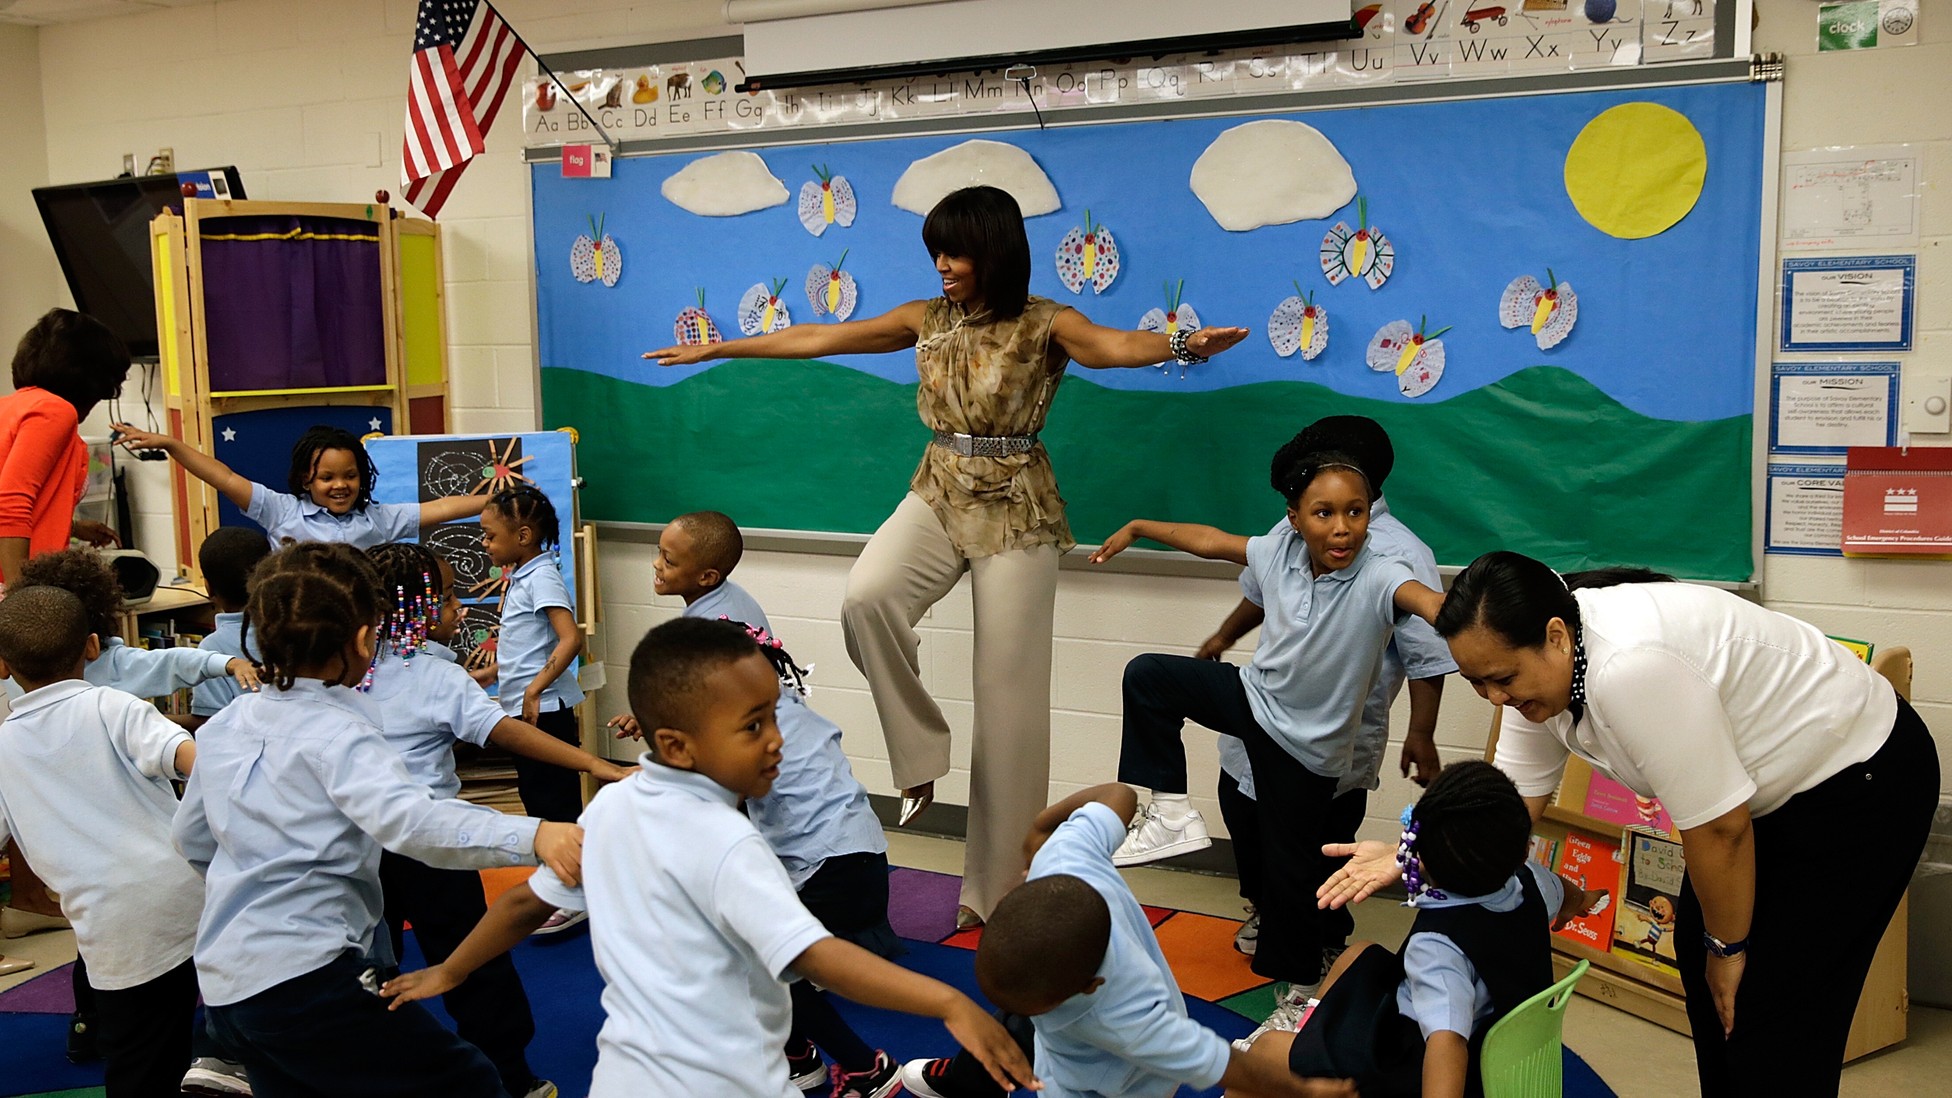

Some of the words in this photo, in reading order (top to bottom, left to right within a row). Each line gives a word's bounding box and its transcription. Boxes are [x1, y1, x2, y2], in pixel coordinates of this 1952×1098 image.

[1829, 20, 1865, 34] clock
[535, 115, 558, 132] Aa
[568, 112, 588, 131] Bb
[602, 110, 623, 128] Cc
[634, 108, 657, 128] Dd
[669, 104, 690, 124] Ee
[704, 100, 726, 120] Ff
[736, 98, 762, 125] Gg
[856, 88, 877, 116] Jj
[891, 85, 915, 106] Kk
[933, 82, 953, 103] Ll
[965, 78, 1002, 100] Mm
[1056, 72, 1086, 94] Oo
[1100, 68, 1128, 98] Pp
[1147, 67, 1184, 96] Qq
[1199, 62, 1224, 84] Rr
[1249, 56, 1276, 78] Ss
[1352, 48, 1383, 71] Uu
[1410, 42, 1440, 66] Vv
[1458, 38, 1508, 62] Ww
[1525, 34, 1560, 58] Xx
[1589, 28, 1622, 63] Yy
[1661, 20, 1696, 46] Zz
[569, 154, 584, 166] flag
[1569, 836, 1592, 850] Green
[1642, 840, 1674, 857] David
[1572, 849, 1592, 864] Eggs
[1641, 853, 1650, 866] to
[1657, 857, 1684, 872] Scho
[1564, 863, 1579, 873] and
[1565, 920, 1578, 932] Dr.
[1578, 922, 1598, 940] Seuss
